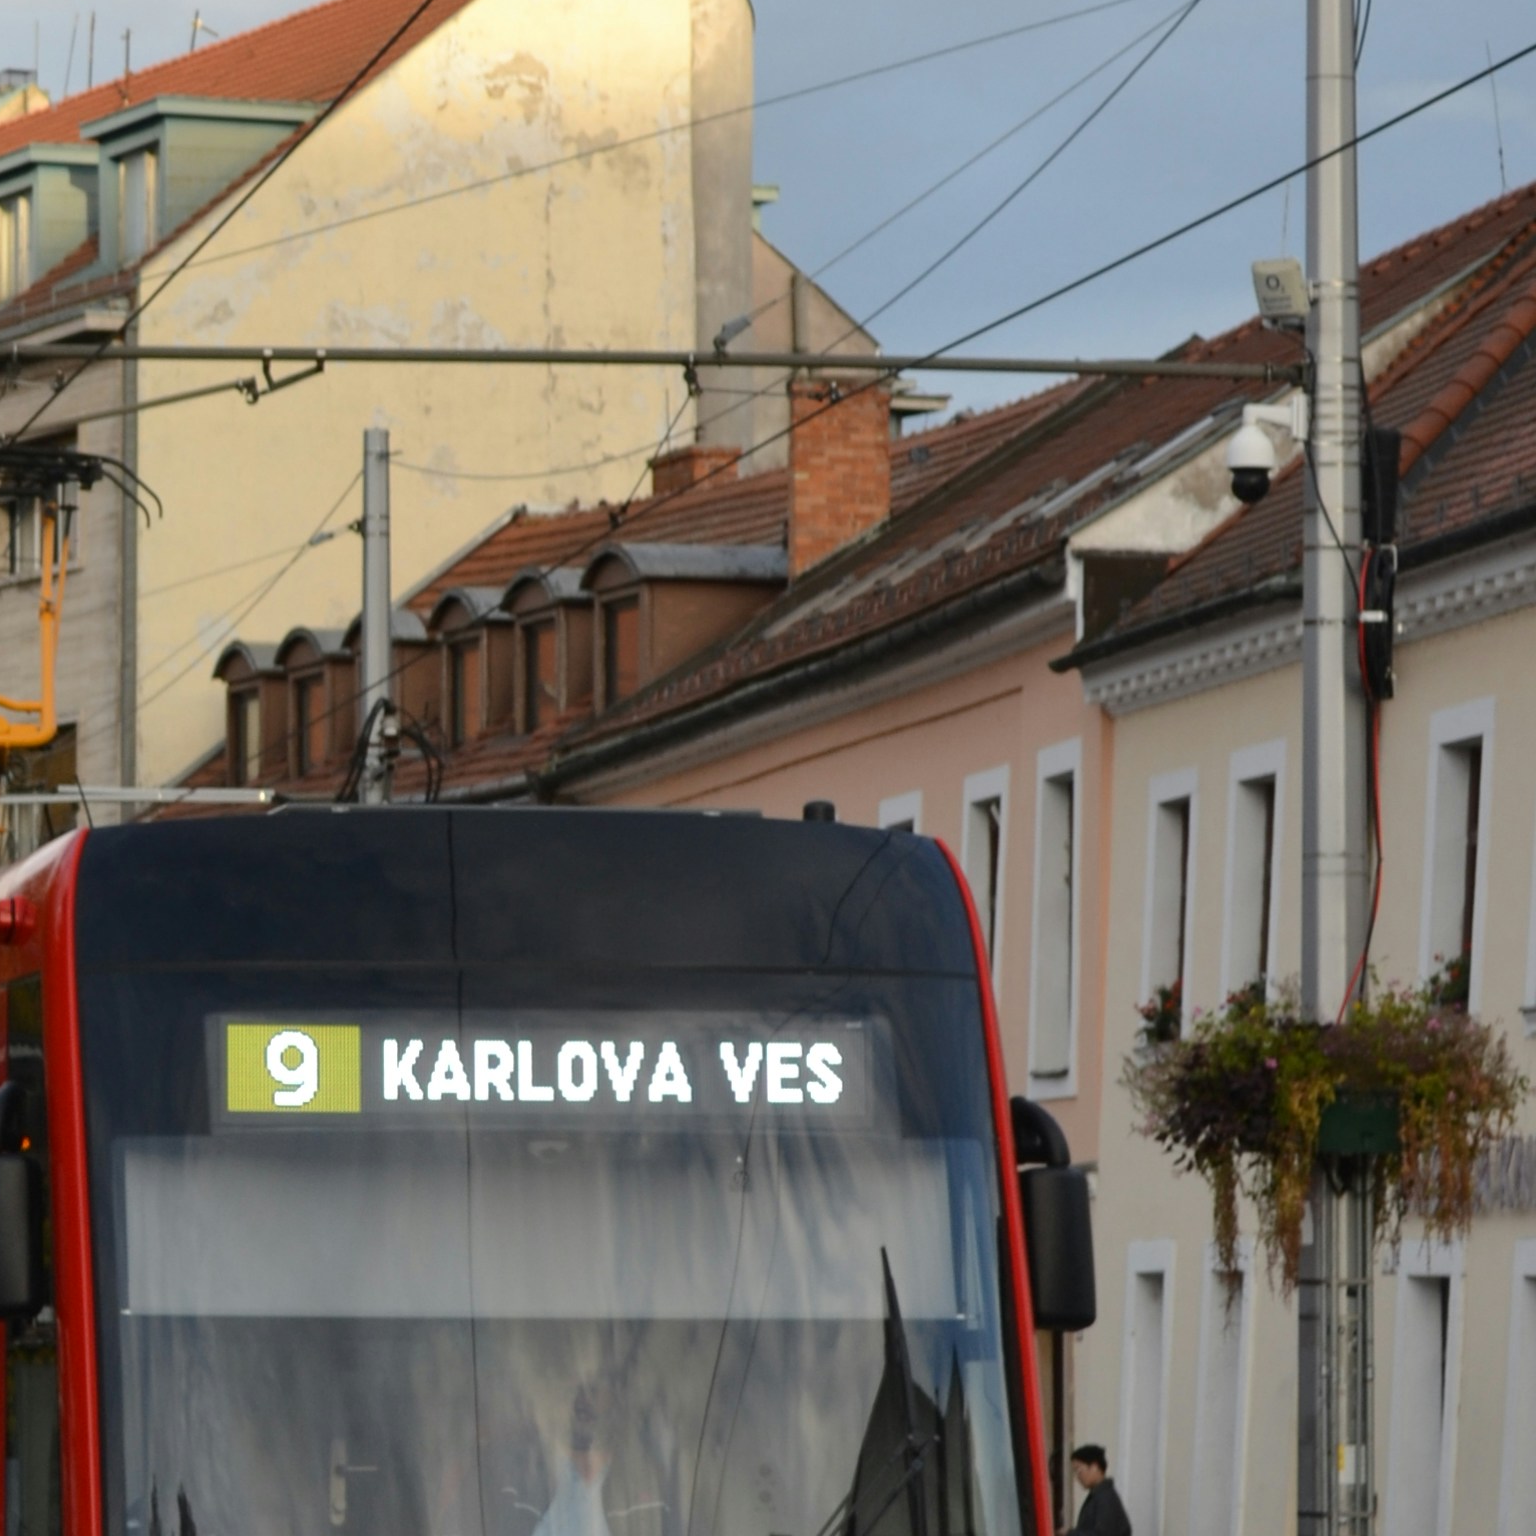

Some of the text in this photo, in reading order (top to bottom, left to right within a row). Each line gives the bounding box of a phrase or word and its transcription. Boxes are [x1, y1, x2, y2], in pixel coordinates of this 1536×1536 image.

[265, 1030, 844, 1107] 9 KARLOVA VES
